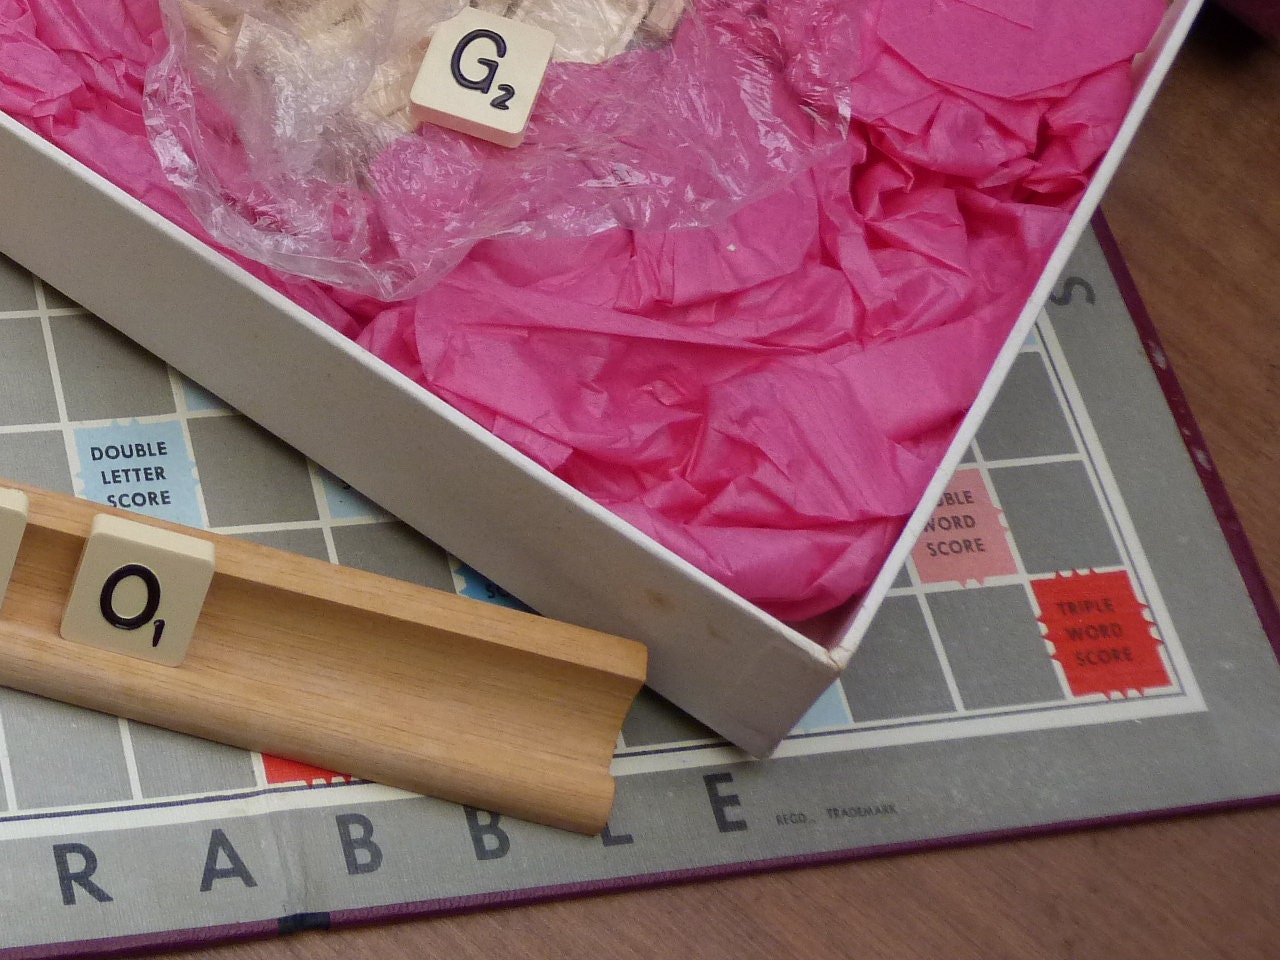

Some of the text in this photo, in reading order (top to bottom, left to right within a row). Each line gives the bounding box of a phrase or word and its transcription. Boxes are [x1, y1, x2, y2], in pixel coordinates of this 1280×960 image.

[91, 442, 167, 460] DOUBLE
[101, 467, 166, 484] LETTER
[107, 491, 171, 508] SCORE
[926, 538, 986, 557] SCORE
[1056, 598, 1115, 617] TRIPLE
[1065, 622, 1124, 641] WORD
[1075, 646, 1134, 667] SCORE
